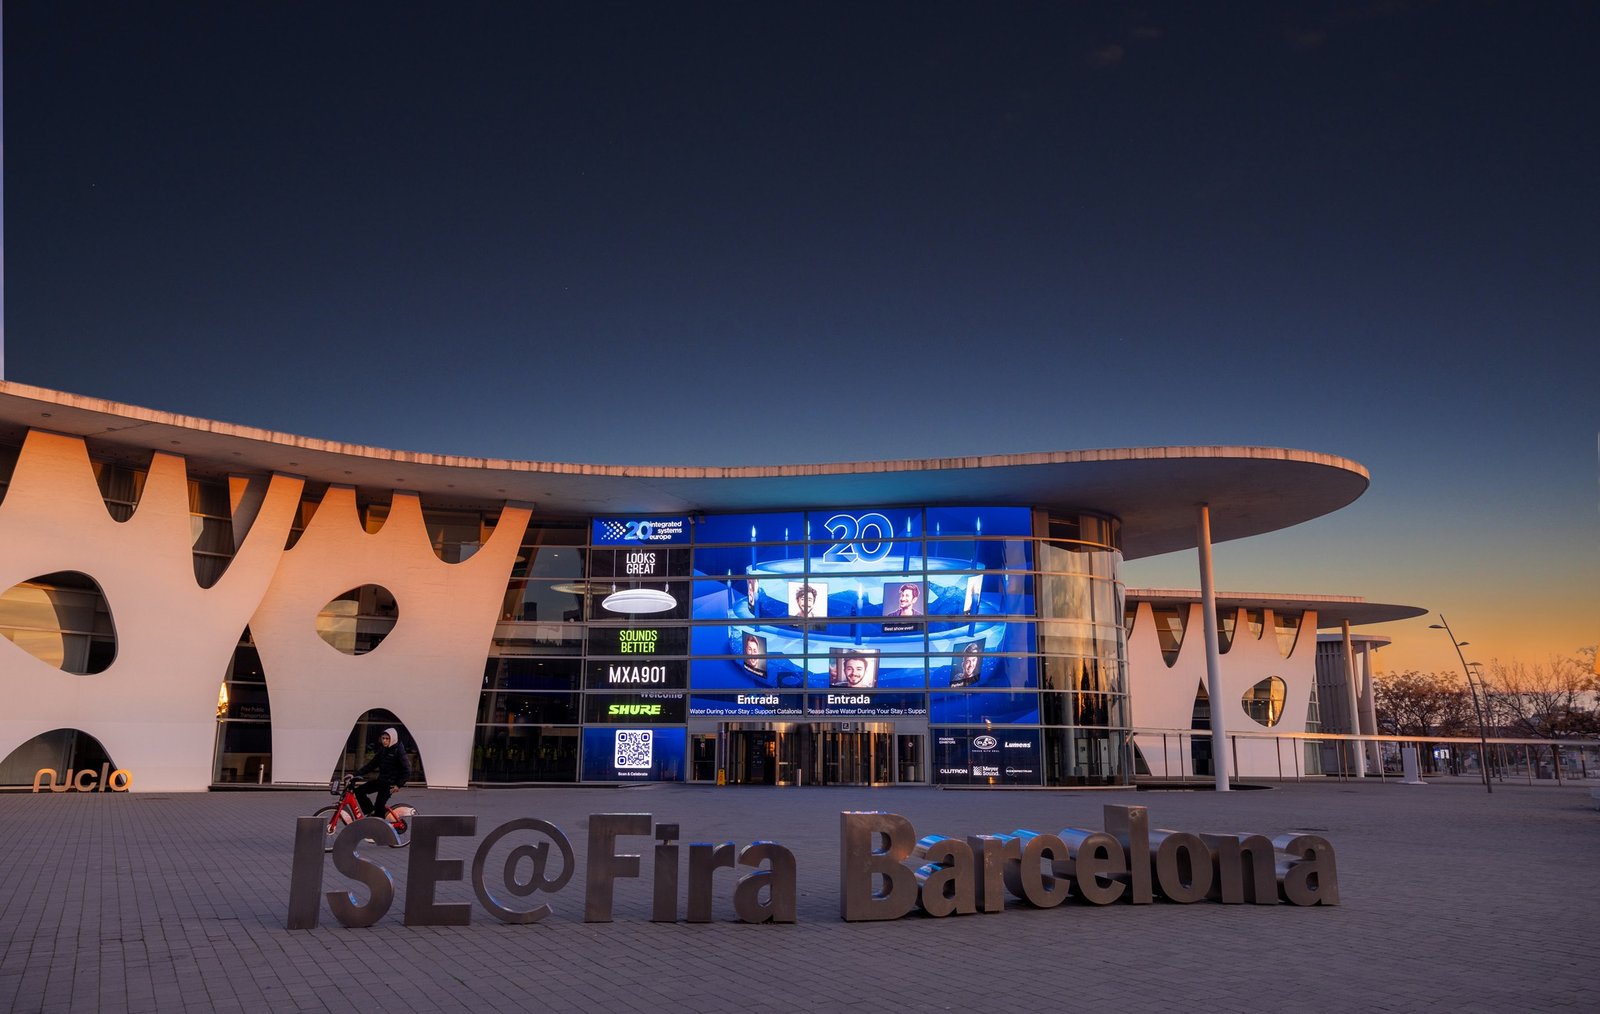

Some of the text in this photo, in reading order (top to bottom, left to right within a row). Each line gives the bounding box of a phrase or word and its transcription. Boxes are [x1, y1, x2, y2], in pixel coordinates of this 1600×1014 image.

[624, 521, 652, 540] 20
[823, 513, 894, 564] 20
[626, 553, 656, 564] LOOKS
[626, 564, 655, 574] GREAT
[619, 630, 658, 641] SOUNDS
[621, 642, 655, 653] BETTER
[609, 666, 666, 683] MXA901
[737, 695, 779, 705] Entrada
[827, 694, 870, 704] Entrada
[608, 705, 662, 715] SHURE
[840, 804, 1341, 922] Barcelona
